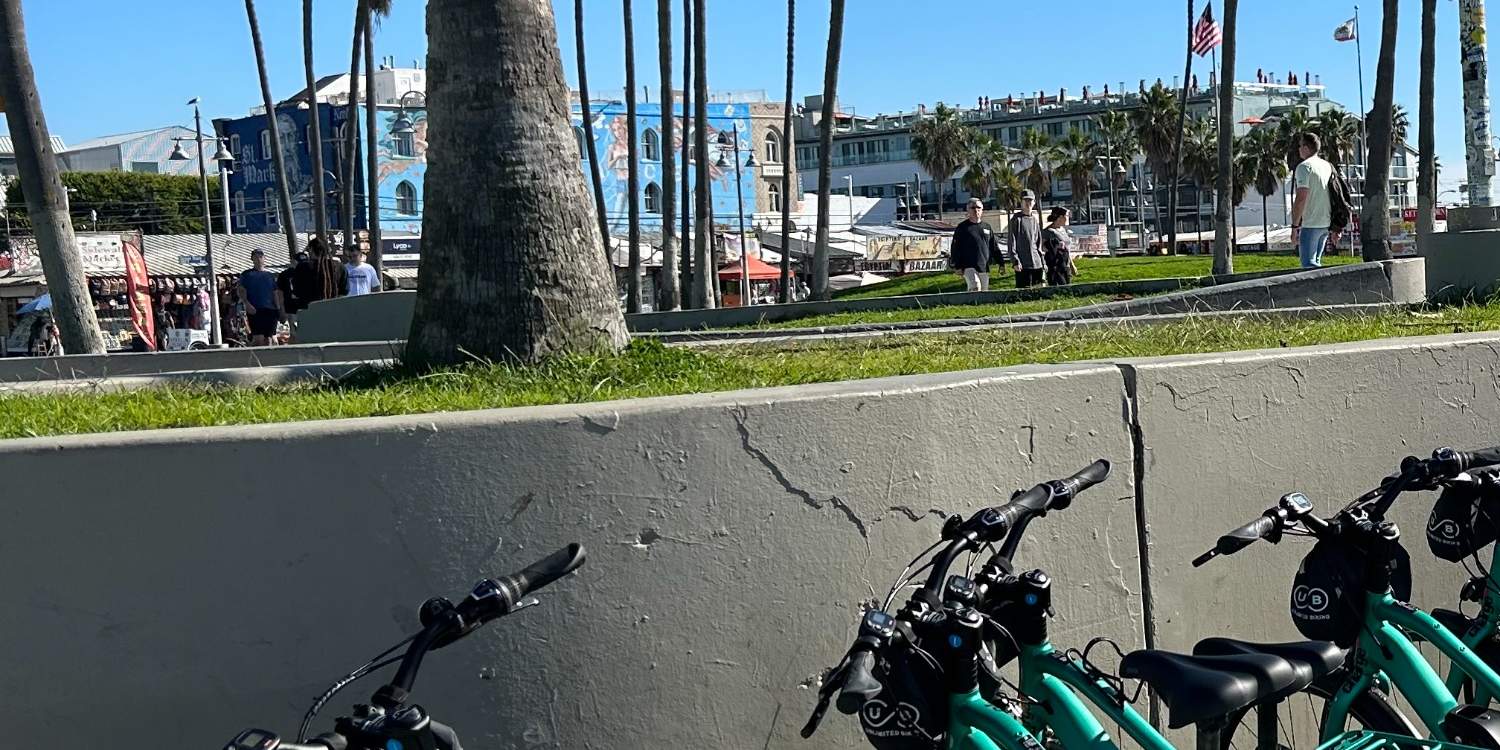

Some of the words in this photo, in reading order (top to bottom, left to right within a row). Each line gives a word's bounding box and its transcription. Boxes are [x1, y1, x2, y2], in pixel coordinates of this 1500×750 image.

[909, 260, 942, 271] BAZAAR
[1312, 595, 1322, 605] B
[869, 707, 881, 719] U
